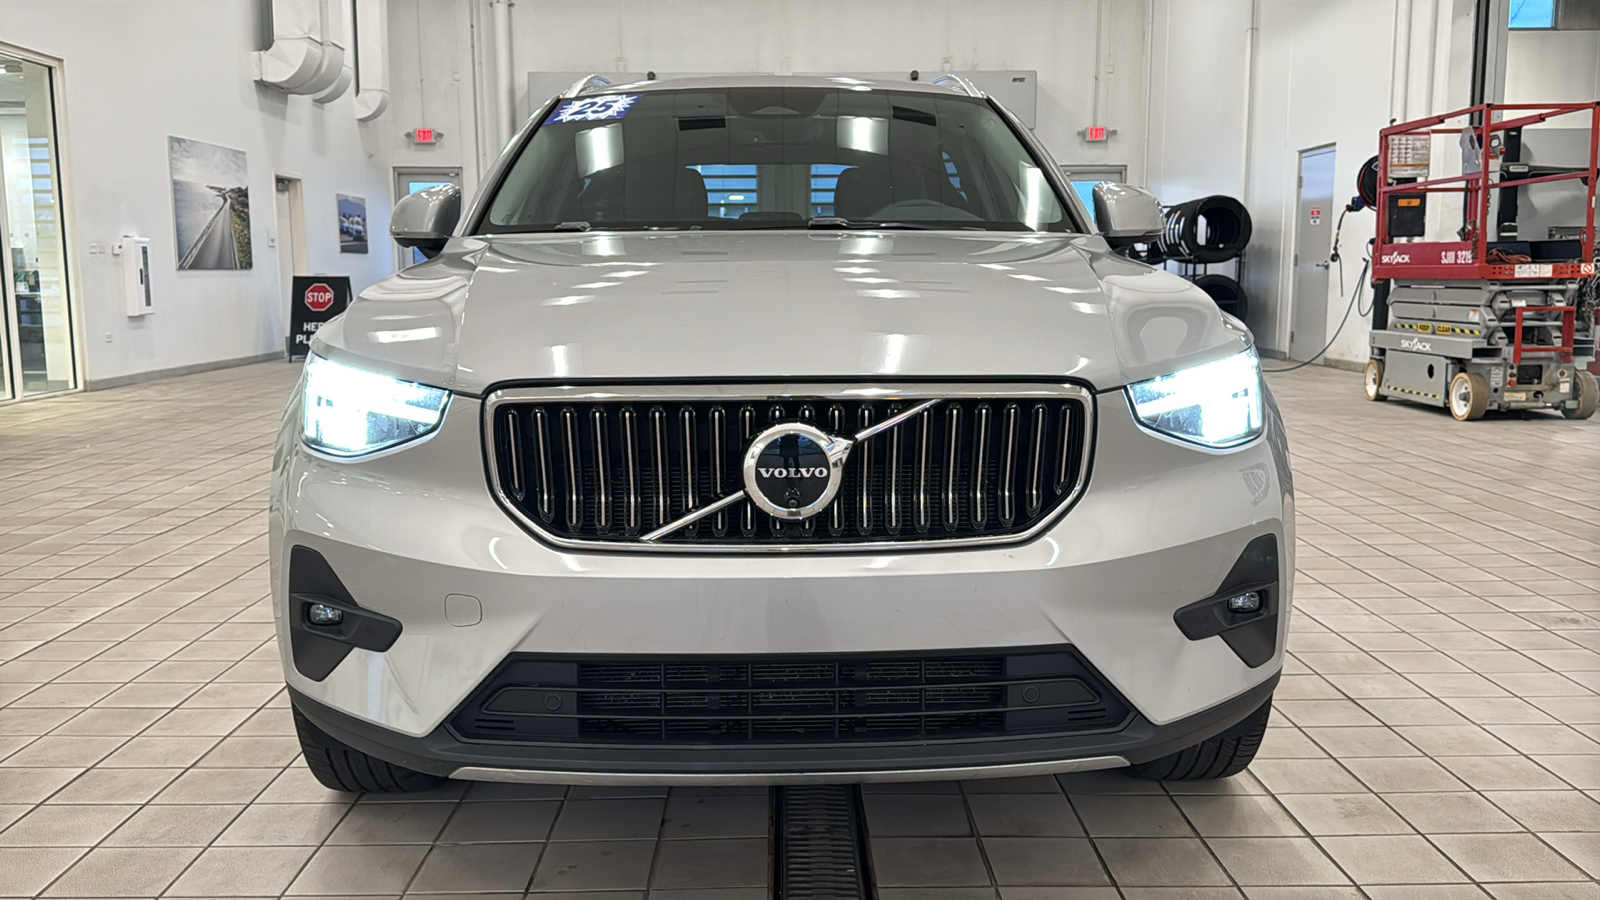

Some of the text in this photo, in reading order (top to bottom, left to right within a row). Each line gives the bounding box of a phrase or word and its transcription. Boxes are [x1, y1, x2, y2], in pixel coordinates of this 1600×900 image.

[568, 100, 620, 116] 25
[417, 129, 432, 141] EXIT
[1381, 251, 1410, 265] SKYJACK
[307, 292, 332, 303] STOP
[303, 322, 325, 332] HER
[1401, 338, 1431, 351] SKYJACK
[757, 467, 828, 478] VOLVO
